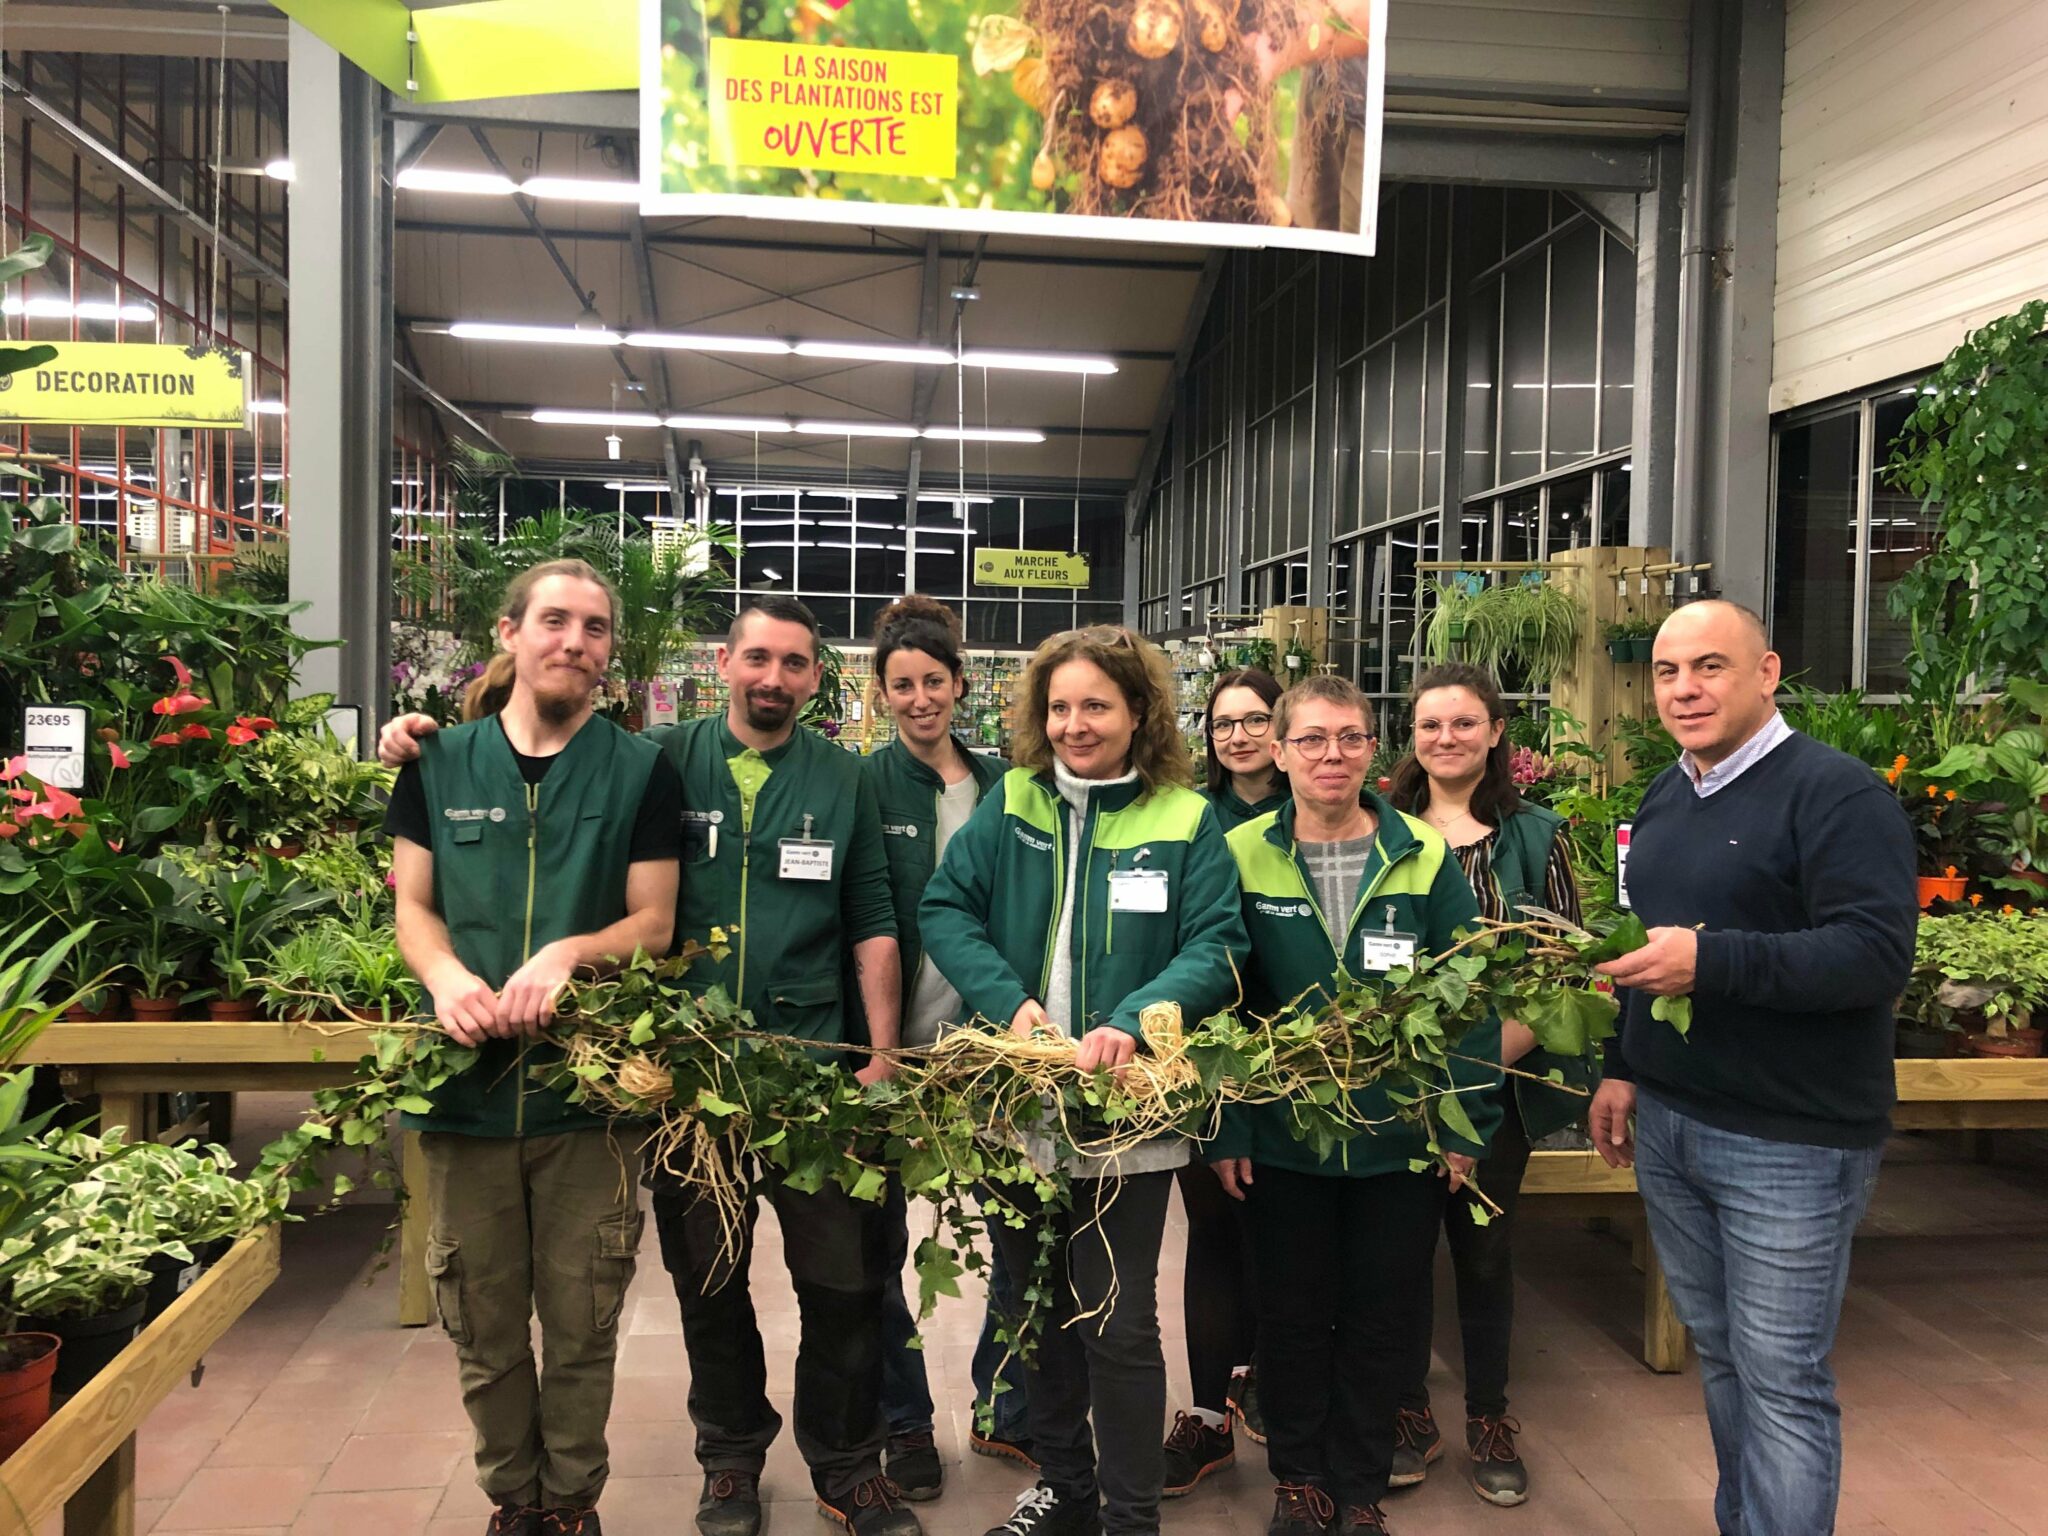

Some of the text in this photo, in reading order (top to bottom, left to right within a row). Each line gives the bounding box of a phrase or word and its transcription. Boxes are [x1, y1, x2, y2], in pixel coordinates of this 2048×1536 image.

[784, 54, 887, 83] LA SAISON
[726, 78, 943, 115] DES PLANTATIONS EST
[764, 117, 906, 158] OUVERTE
[36, 370, 195, 396] DECORATION
[1015, 556, 1058, 567] MARCHE
[1004, 568, 1068, 580] AUX FLEURS
[28, 714, 70, 726] 23€95
[784, 859, 829, 867] JEAN-BAPTISTE
